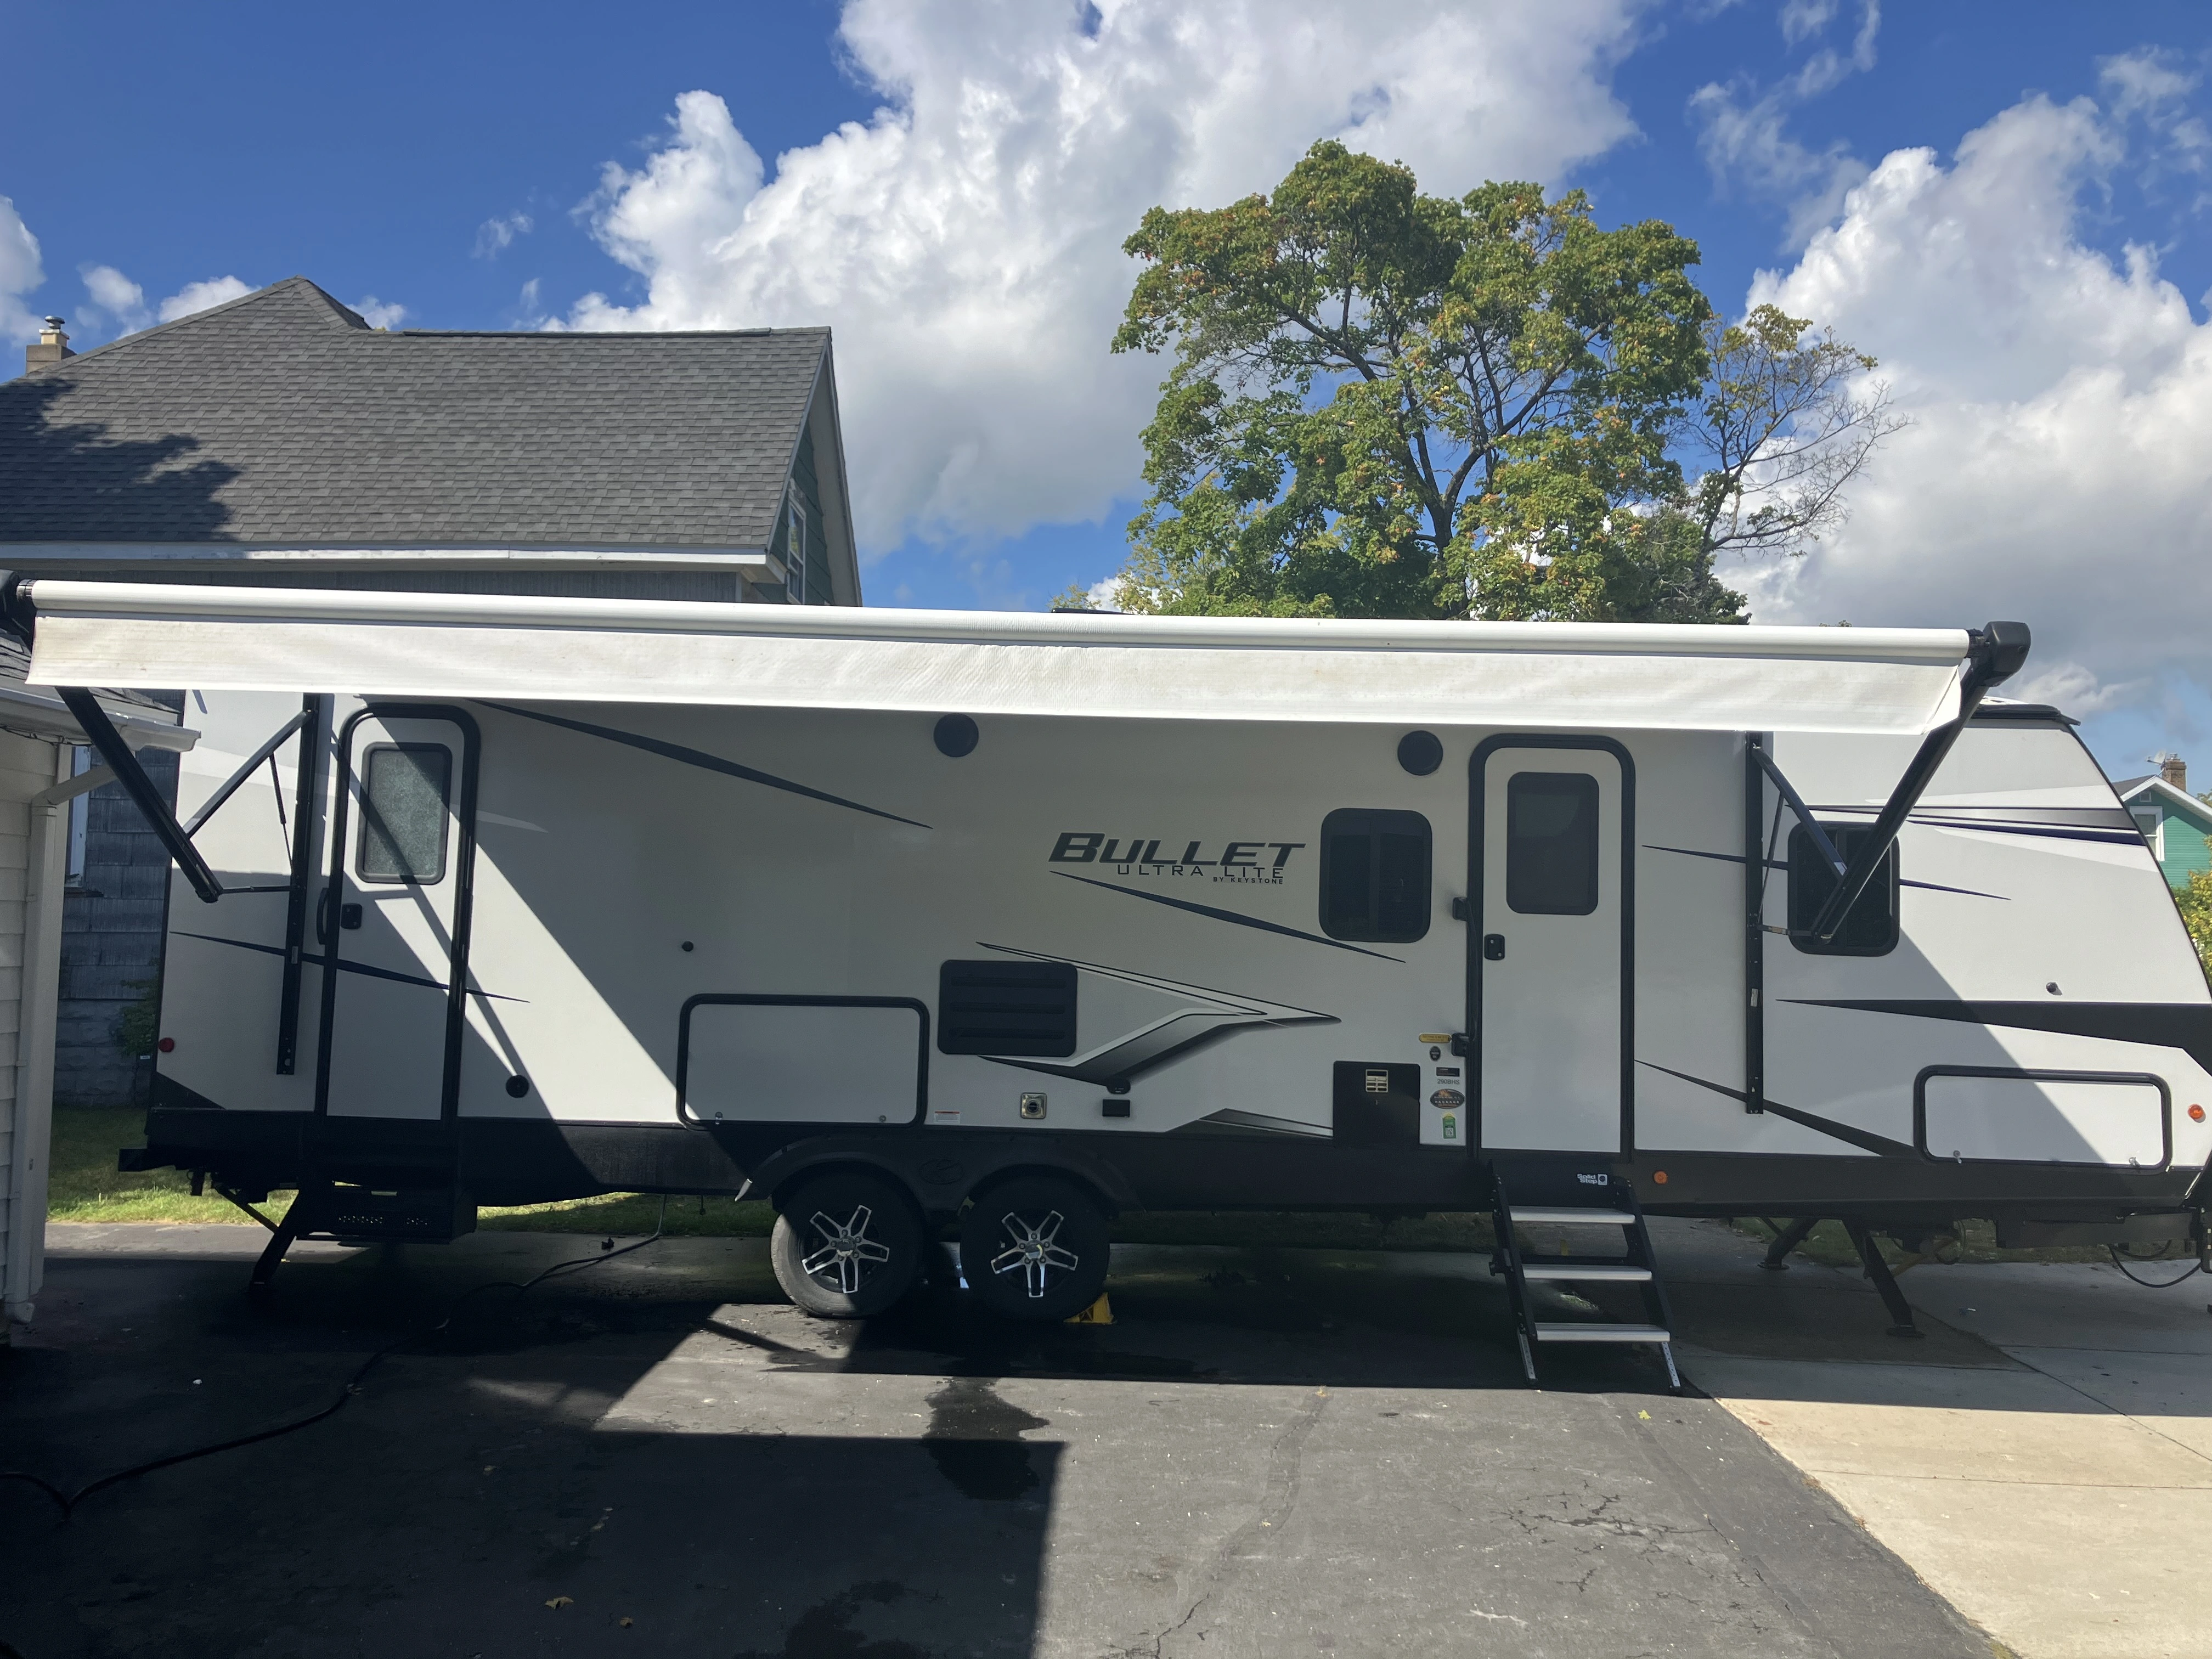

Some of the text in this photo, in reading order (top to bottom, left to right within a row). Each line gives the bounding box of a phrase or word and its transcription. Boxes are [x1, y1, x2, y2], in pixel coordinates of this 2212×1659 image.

[1048, 832, 1306, 867] BULLET
[1118, 864, 1283, 878] ULTRA LITE
